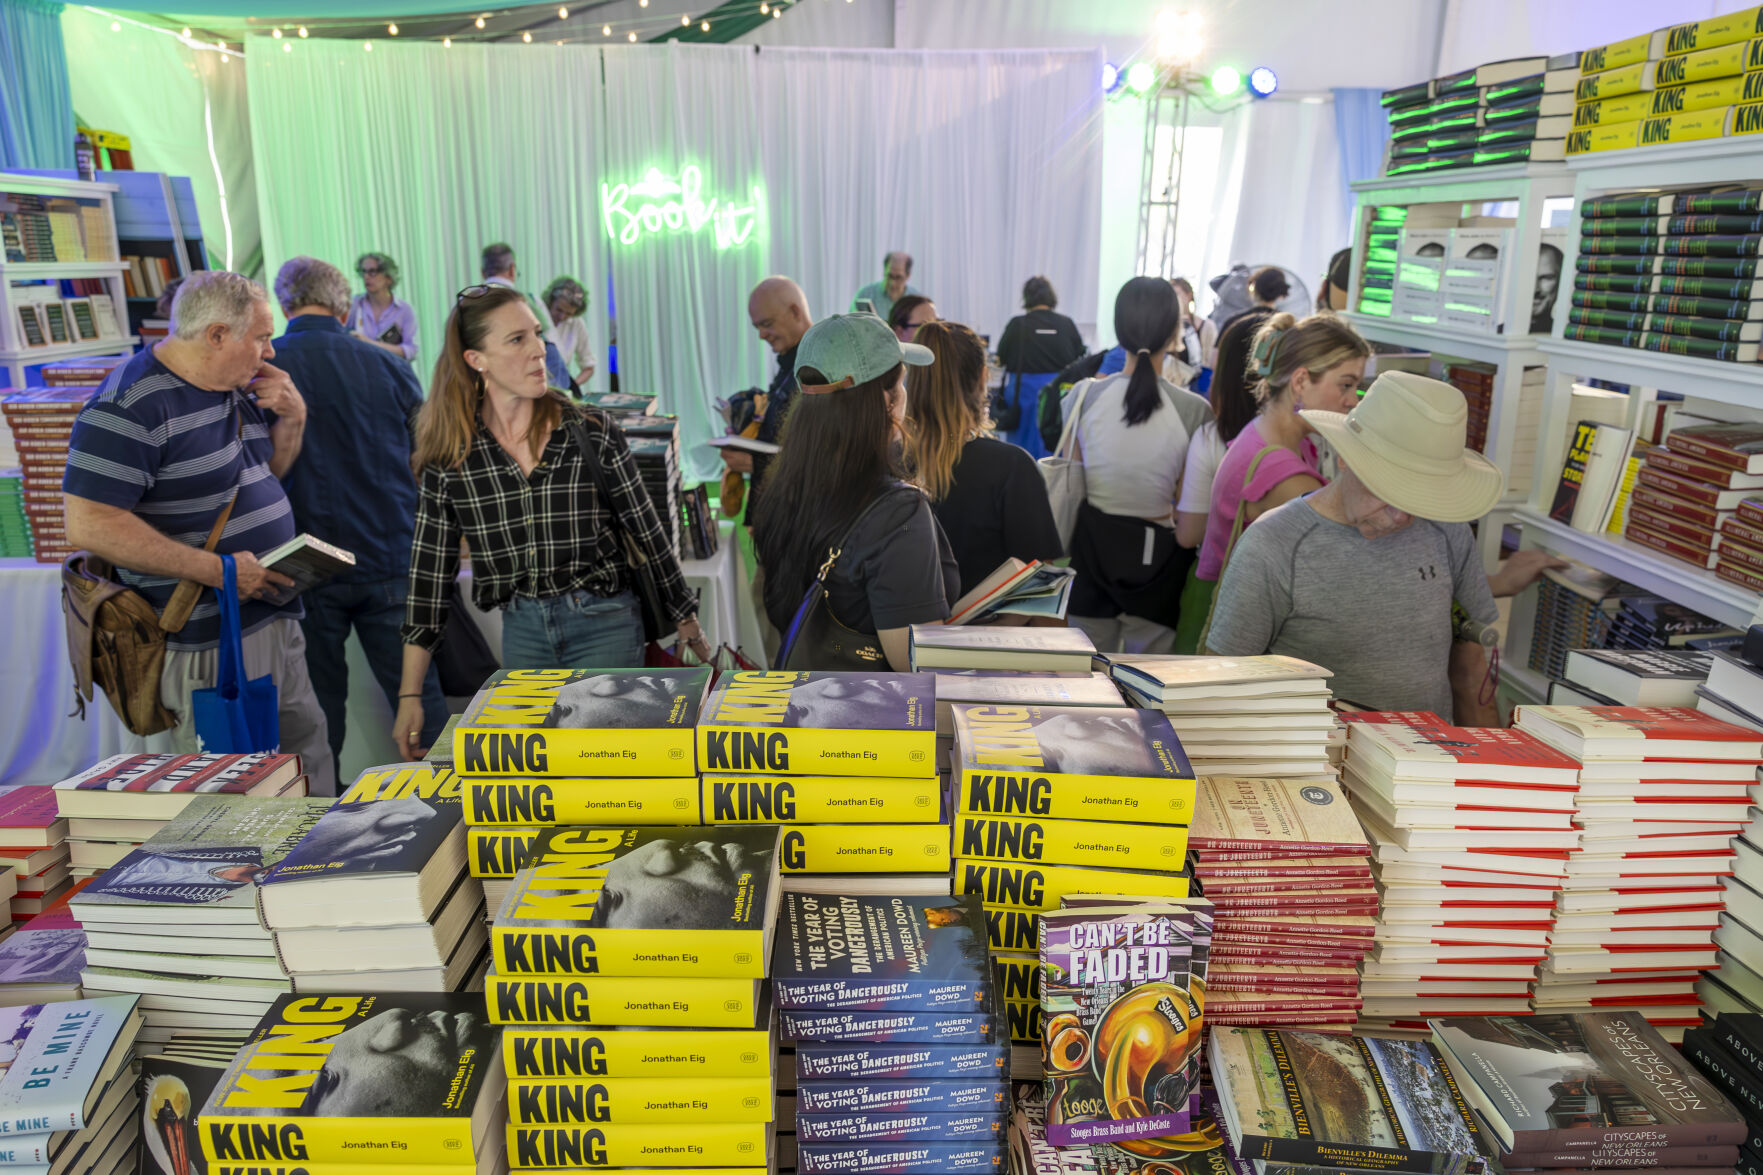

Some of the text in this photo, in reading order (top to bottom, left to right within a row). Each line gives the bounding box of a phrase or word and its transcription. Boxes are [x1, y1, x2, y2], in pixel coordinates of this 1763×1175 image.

[1668, 24, 1698, 52] KING
[1583, 46, 1607, 72] KING
[1657, 56, 1687, 84] KING
[1577, 76, 1599, 100] KING
[1652, 87, 1685, 114] KING
[1567, 130, 1591, 152] KING
[1642, 117, 1671, 143] KING
[474, 669, 575, 724] KING
[716, 671, 798, 723] KING
[707, 731, 789, 770] KING
[966, 707, 1044, 767] KING
[464, 733, 548, 772] KING
[579, 750, 637, 760] Jonathan Eig
[820, 750, 878, 760] Jonathan Eig
[472, 784, 556, 822] KING
[714, 782, 796, 820] KING
[968, 775, 1052, 815] KING
[1082, 796, 1138, 807] Jonathan Eig
[627, 829, 639, 841] Life
[962, 818, 1044, 860] KING
[1074, 842, 1130, 854] Jonathan Eig
[477, 836, 540, 873] KIN
[836, 847, 893, 856] Jonathan Eig
[278, 862, 345, 874] Jonathan Eig
[513, 830, 625, 920] KING
[731, 873, 751, 922] Jonathan Eig
[964, 864, 1045, 907] KING
[787, 894, 797, 922] BESTSELLER
[891, 898, 909, 927] DOWD
[802, 896, 828, 970] THE YEAR OF
[822, 906, 847, 960] VOTING
[839, 896, 872, 974] DANGEROUSLY
[867, 913, 882, 951] DERANGEMENT
[876, 908, 895, 960] AMERICAN POLITICS
[1069, 921, 1171, 950] CAN'T BE
[503, 934, 600, 973] KING
[632, 953, 698, 963] Jonathan Eig
[793, 942, 801, 957] YORK
[875, 952, 885, 963] THE
[898, 927, 921, 973] MAUREEN
[1069, 947, 1170, 985] FADED
[496, 982, 591, 1022] KING
[789, 982, 845, 995] THE YEAR OF
[792, 992, 835, 1004] VOTING
[839, 983, 909, 1000] DANGEROUSLY
[929, 985, 966, 994] MAUREEN
[935, 992, 960, 1000] DOWD
[1080, 998, 1090, 1006] New
[357, 996, 377, 1017] A Life
[1076, 1007, 1101, 1016] Brass Band
[1157, 999, 1184, 1031] Stooges
[22, 1010, 92, 1090] BE MINE
[222, 996, 363, 1108] KING
[514, 1037, 608, 1076] KING
[813, 1052, 869, 1066] THE YEAR OF
[816, 1052, 930, 1074] VOTING DANGEROUSLY
[951, 1052, 987, 1061] MAUREEN
[1726, 1034, 1763, 1072] ABOVE
[442, 1049, 475, 1109] Jonathan Eig
[1601, 1025, 1687, 1111] CITYSCAPES OF
[1612, 1020, 1706, 1110] NEW ORLEANS
[1696, 1050, 1735, 1087] ABOVE
[1270, 1030, 1310, 1135] BIENVILLE'S DILEMMA
[1437, 1057, 1478, 1133] RICHARD CAMPANELLA
[518, 1084, 611, 1123] KING
[16, 1116, 50, 1132] MINE
[1071, 1120, 1170, 1139] Stooges Brass Band and Kyle DeCoste
[1604, 1132, 1657, 1141] CITYSCAPES
[209, 1123, 310, 1161] KING
[341, 1140, 407, 1150] Jonathan Eig
[1317, 1146, 1407, 1161] BIENVILLE'S DILEMMA
[1592, 1149, 1646, 1157] CITYSCAPES
[1602, 1140, 1668, 1149] NEW ORLEANS
